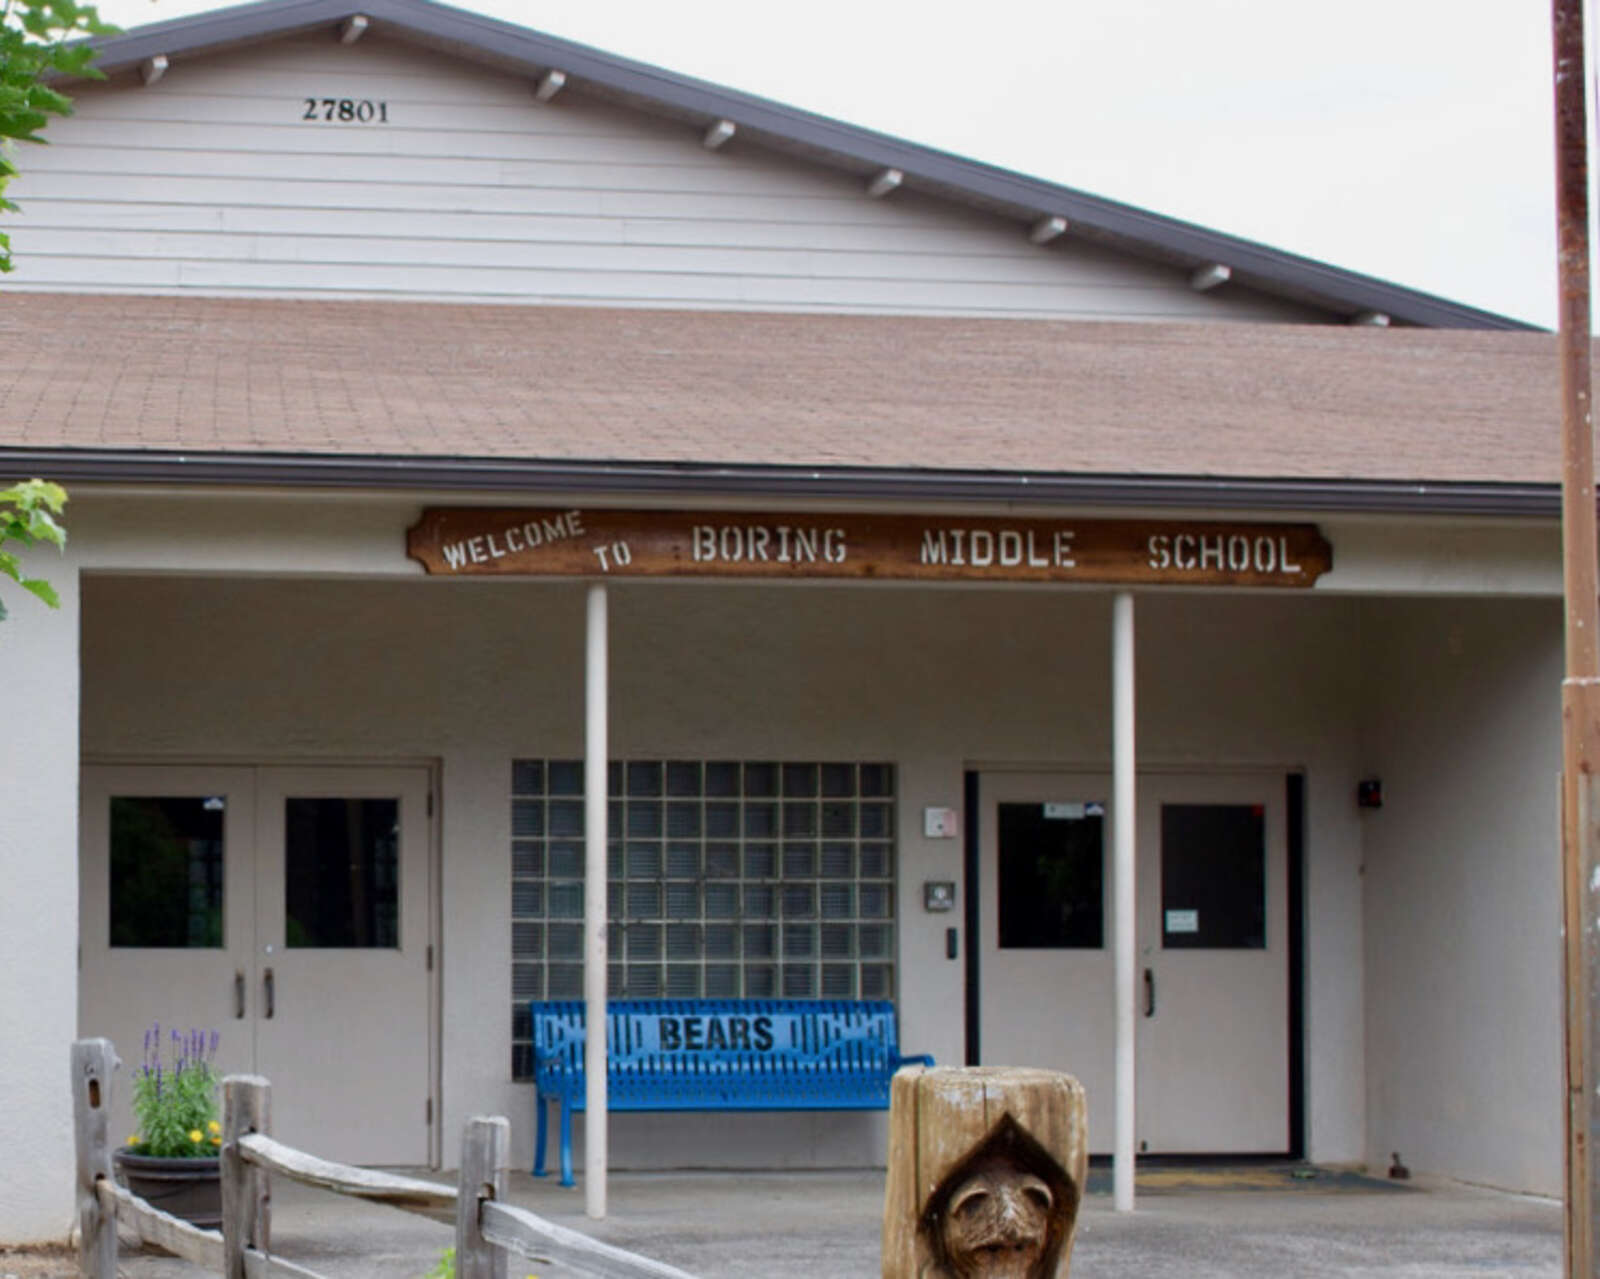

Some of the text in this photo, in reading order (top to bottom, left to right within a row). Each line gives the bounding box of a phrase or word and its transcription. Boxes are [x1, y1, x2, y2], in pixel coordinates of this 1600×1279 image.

[303, 98, 388, 123] 27801
[443, 510, 1300, 573] WELCOME TO BORING MIDDLE SCHOOL
[659, 1017, 774, 1051] BEARS
